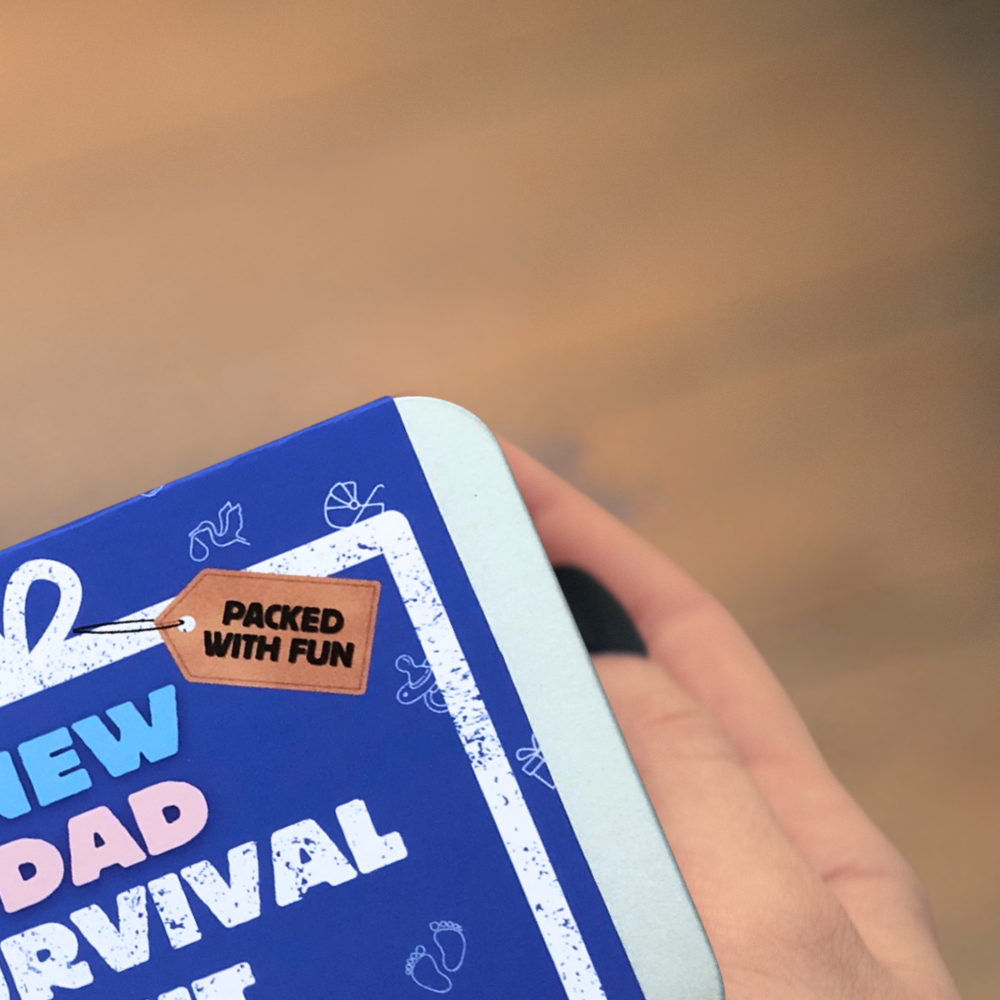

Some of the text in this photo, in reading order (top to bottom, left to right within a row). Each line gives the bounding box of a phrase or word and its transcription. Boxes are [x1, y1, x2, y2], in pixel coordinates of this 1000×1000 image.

[222, 600, 345, 634] PACKED
[203, 630, 355, 668] WITH FUN
